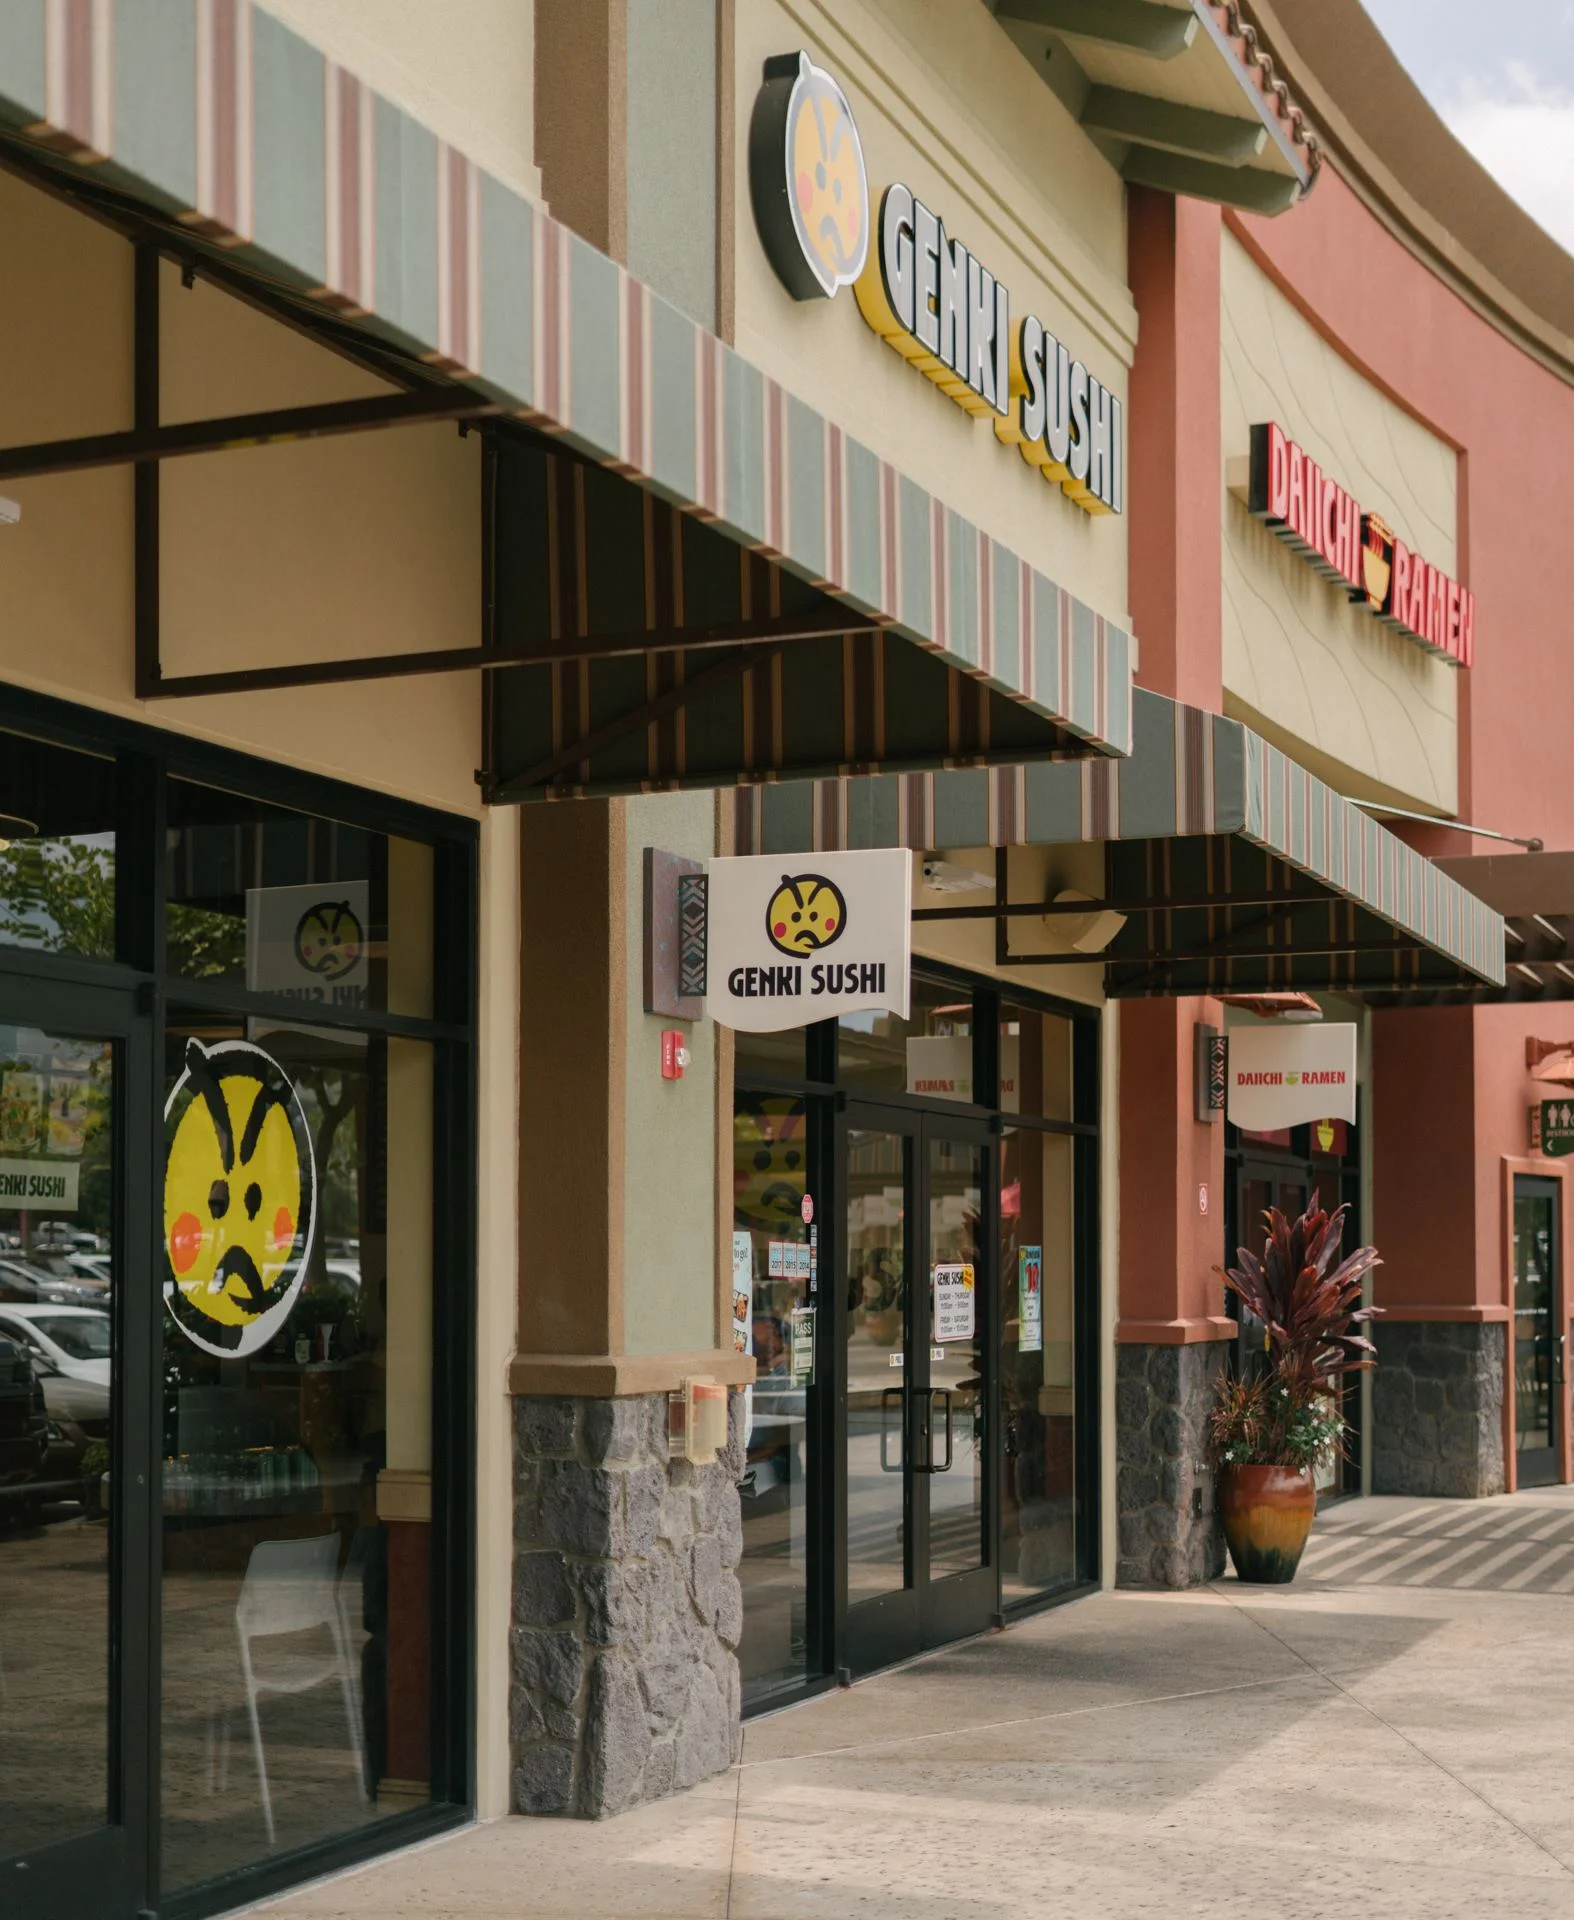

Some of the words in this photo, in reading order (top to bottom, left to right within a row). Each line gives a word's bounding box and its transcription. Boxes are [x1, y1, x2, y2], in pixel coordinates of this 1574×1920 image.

[879, 183, 1009, 417] GENKI
[1019, 315, 1122, 515] SUSHI
[1268, 420, 1361, 588] DAIICHI
[1392, 538, 1475, 669] RAMEN
[727, 966, 802, 997] GENKI
[810, 963, 886, 995] SUSHI
[1237, 1071, 1283, 1086] DAIICHI
[1301, 1071, 1346, 1085] RAMEN
[28, 1175, 66, 1198] SUSHI
[937, 1271, 950, 1286] GENKI
[795, 1322, 812, 1335] PASS
